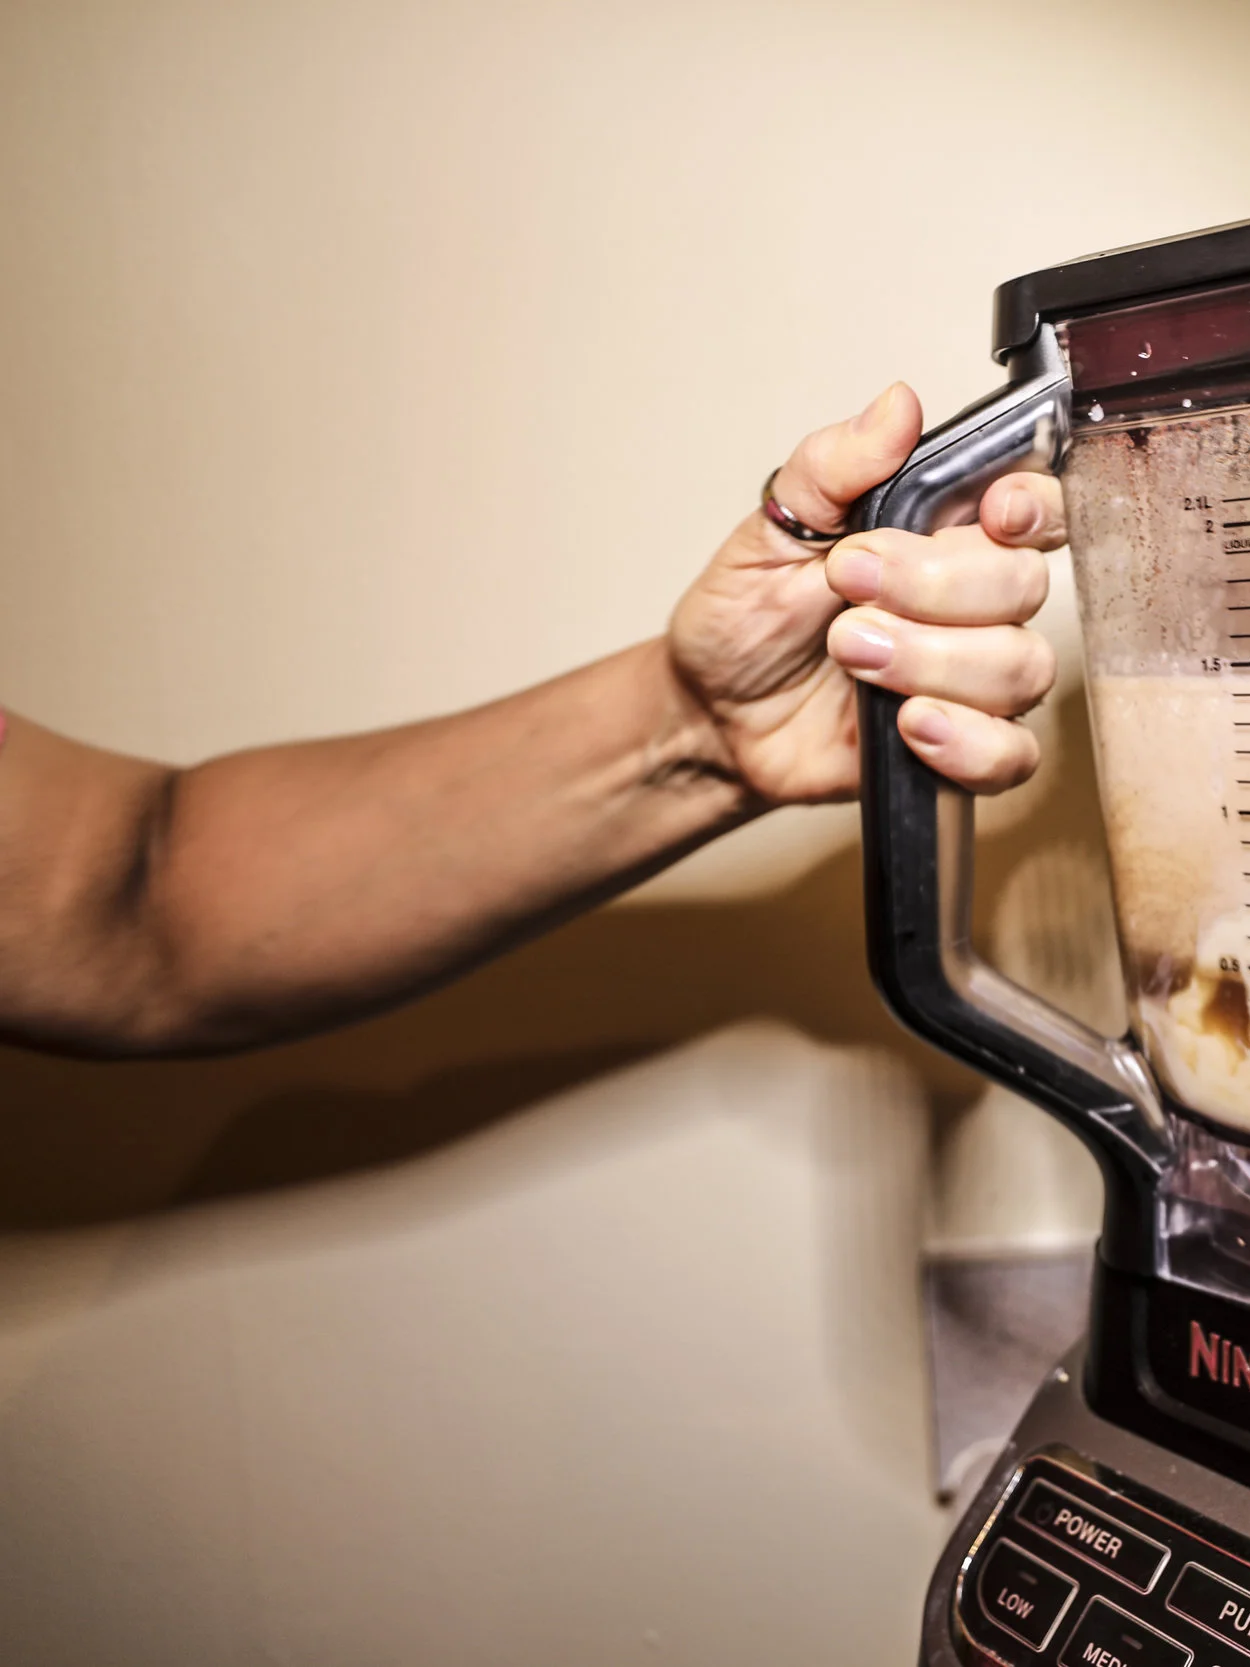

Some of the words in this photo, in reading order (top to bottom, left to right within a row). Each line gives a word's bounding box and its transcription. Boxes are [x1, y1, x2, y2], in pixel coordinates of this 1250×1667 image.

[1184, 496, 1212, 510] 2.1L
[1206, 520, 1214, 533] 2
[1201, 658, 1221, 671] 1.5
[1221, 806, 1229, 820] 1
[1219, 958, 1240, 972] 0.5
[1053, 1508, 1123, 1559] POWER
[997, 1587, 1034, 1619] LOW
